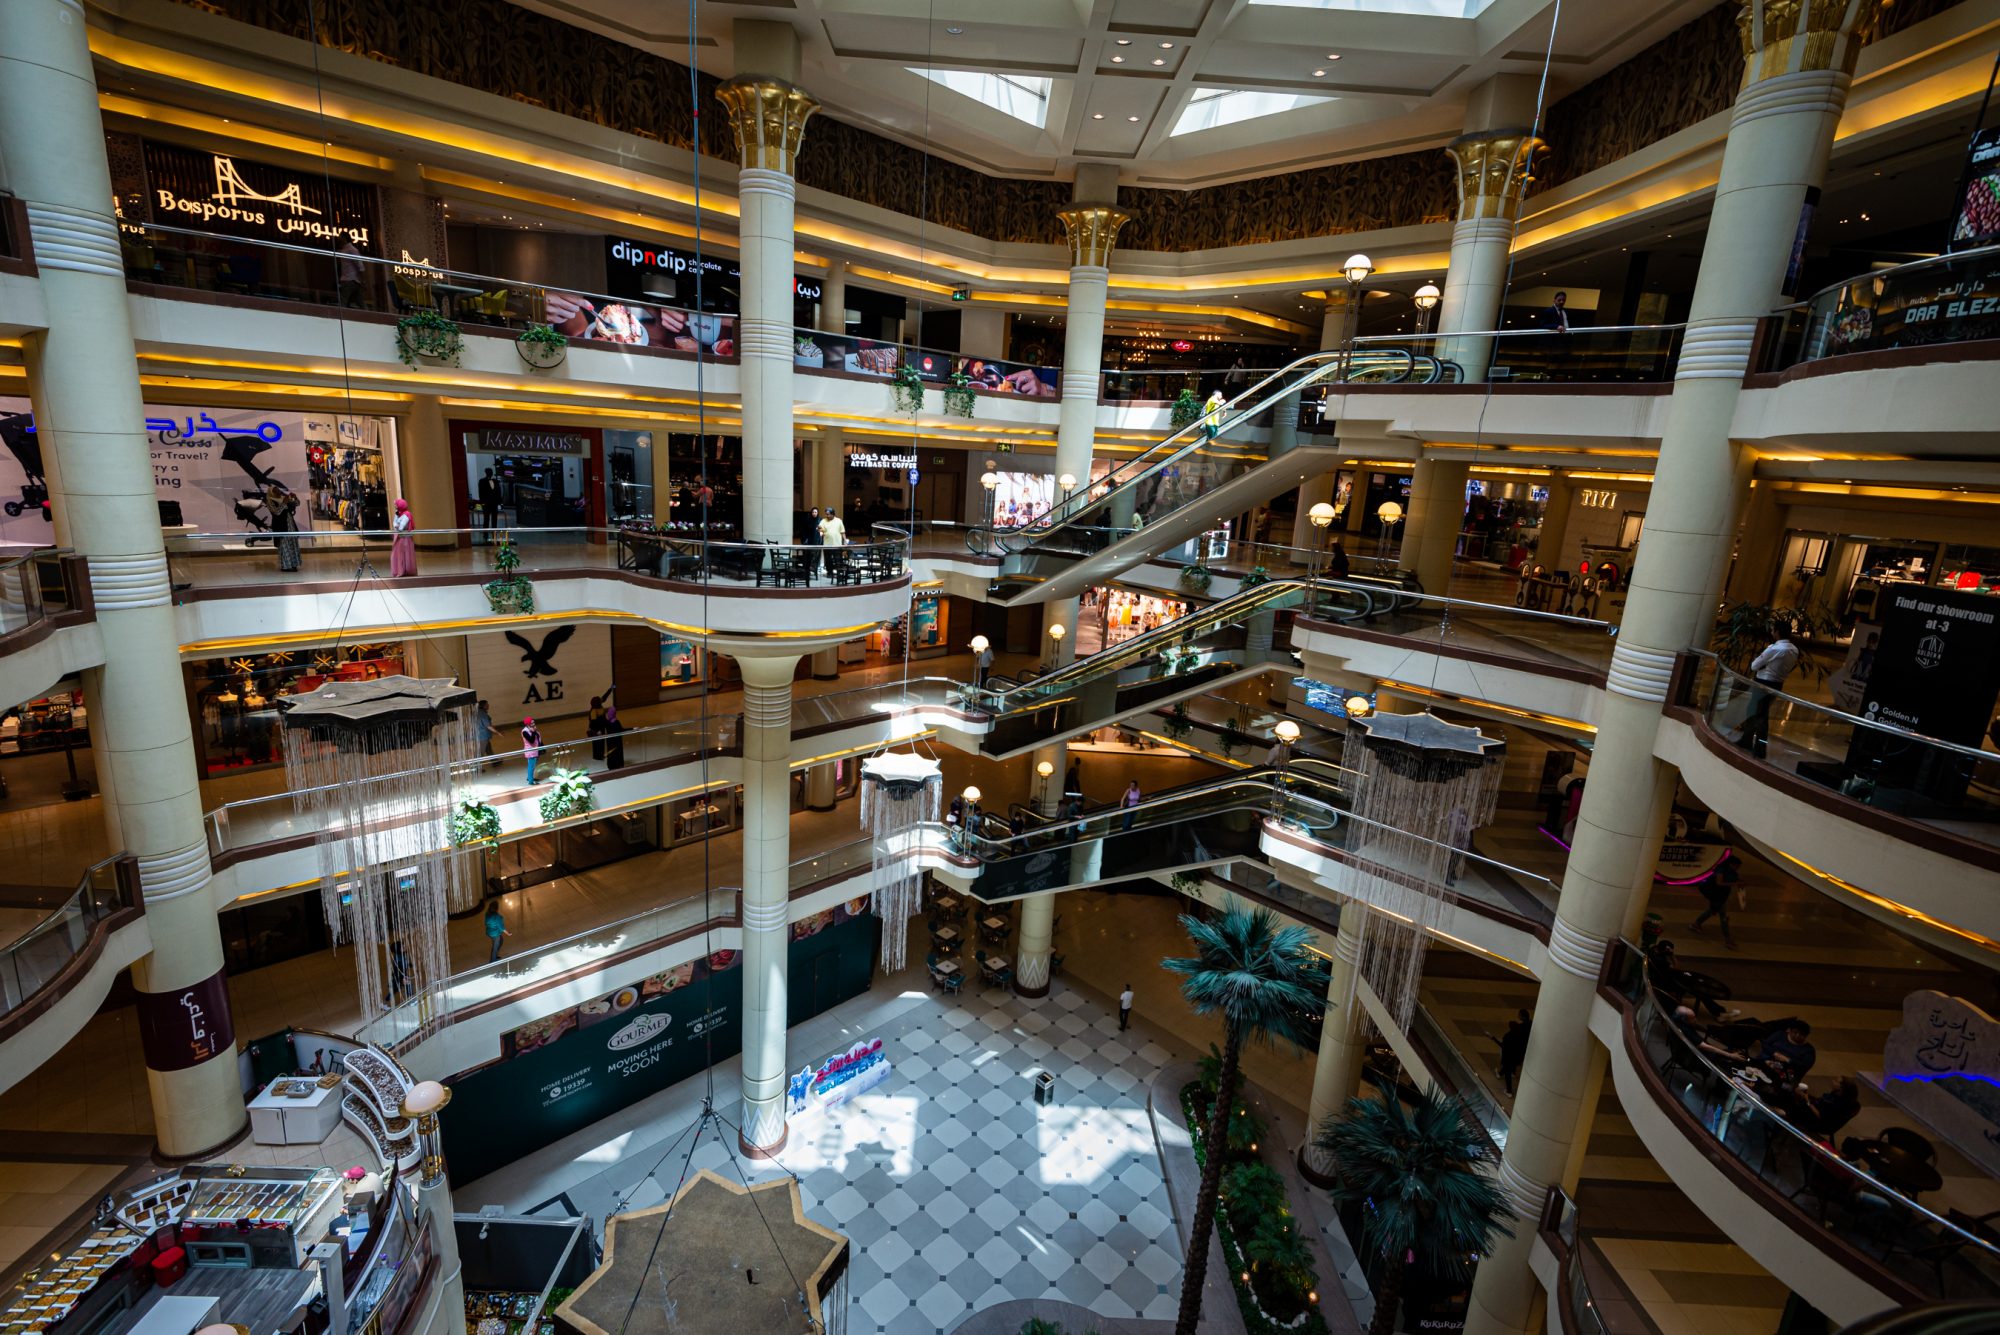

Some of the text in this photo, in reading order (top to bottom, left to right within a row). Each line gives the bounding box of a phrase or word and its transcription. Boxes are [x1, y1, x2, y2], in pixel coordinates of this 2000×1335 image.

[157, 189, 266, 225] Bosporus
[612, 240, 686, 274] dipndip
[688, 258, 722, 272] chcolate
[688, 266, 704, 275] caé
[1903, 296, 2000, 324] DAR ELEZ
[166, 451, 208, 460] Travel?
[1895, 596, 1995, 625] Find our showroom
[1925, 619, 1938, 630] at
[522, 680, 564, 704] AE
[609, 1017, 669, 1048] GOURMET
[607, 1037, 673, 1074] MOVING HERE
[622, 1052, 660, 1077] SOON
[540, 1066, 592, 1093] HOME DELIVERY
[563, 1077, 586, 1093] 19339
